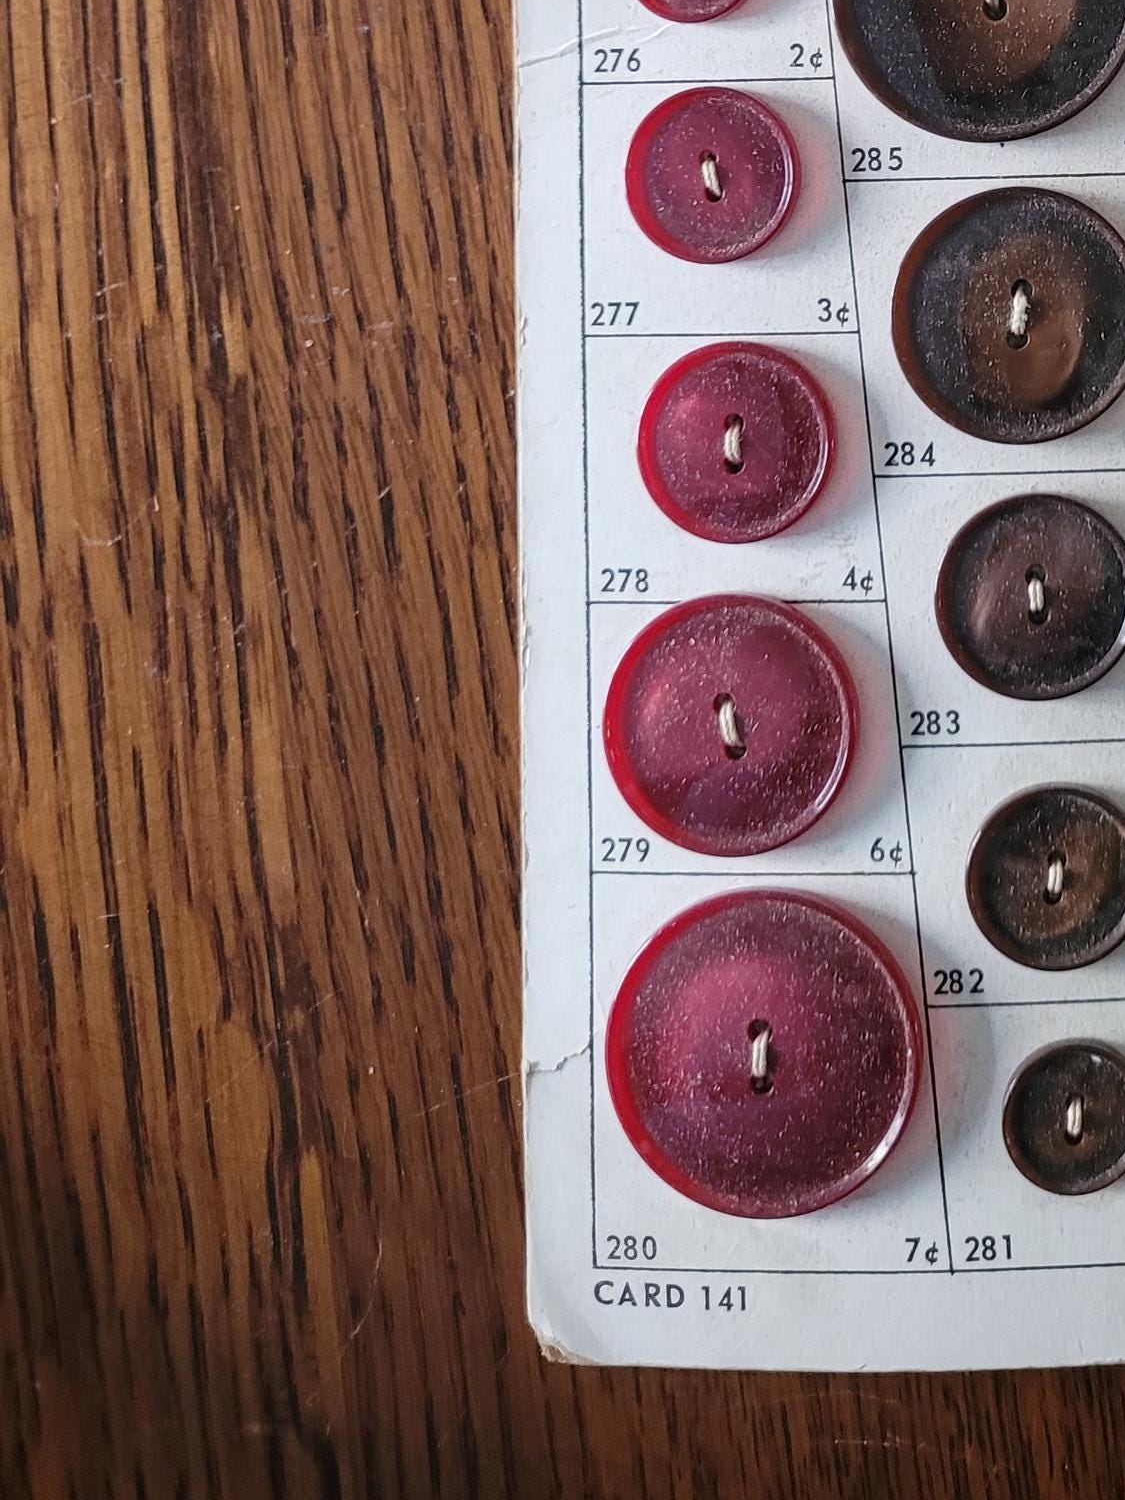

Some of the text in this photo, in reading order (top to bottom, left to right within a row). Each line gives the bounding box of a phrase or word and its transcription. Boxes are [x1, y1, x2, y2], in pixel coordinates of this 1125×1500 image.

[594, 49, 641, 72] 276
[789, 45, 823, 70] 2¢
[851, 147, 903, 172] 285
[590, 302, 639, 326] 277
[817, 299, 850, 324] 3¢
[884, 442, 936, 467] 284
[601, 569, 648, 593] 278
[842, 568, 874, 593] 4¢
[910, 711, 960, 735] 283
[601, 838, 649, 863] 279
[870, 838, 902, 863] 6¢
[934, 968, 985, 995] 282
[607, 1236, 657, 1261] 280
[905, 1238, 939, 1264] 7¢
[964, 1235, 1013, 1261] 281
[594, 1281, 748, 1311] CARD 141
